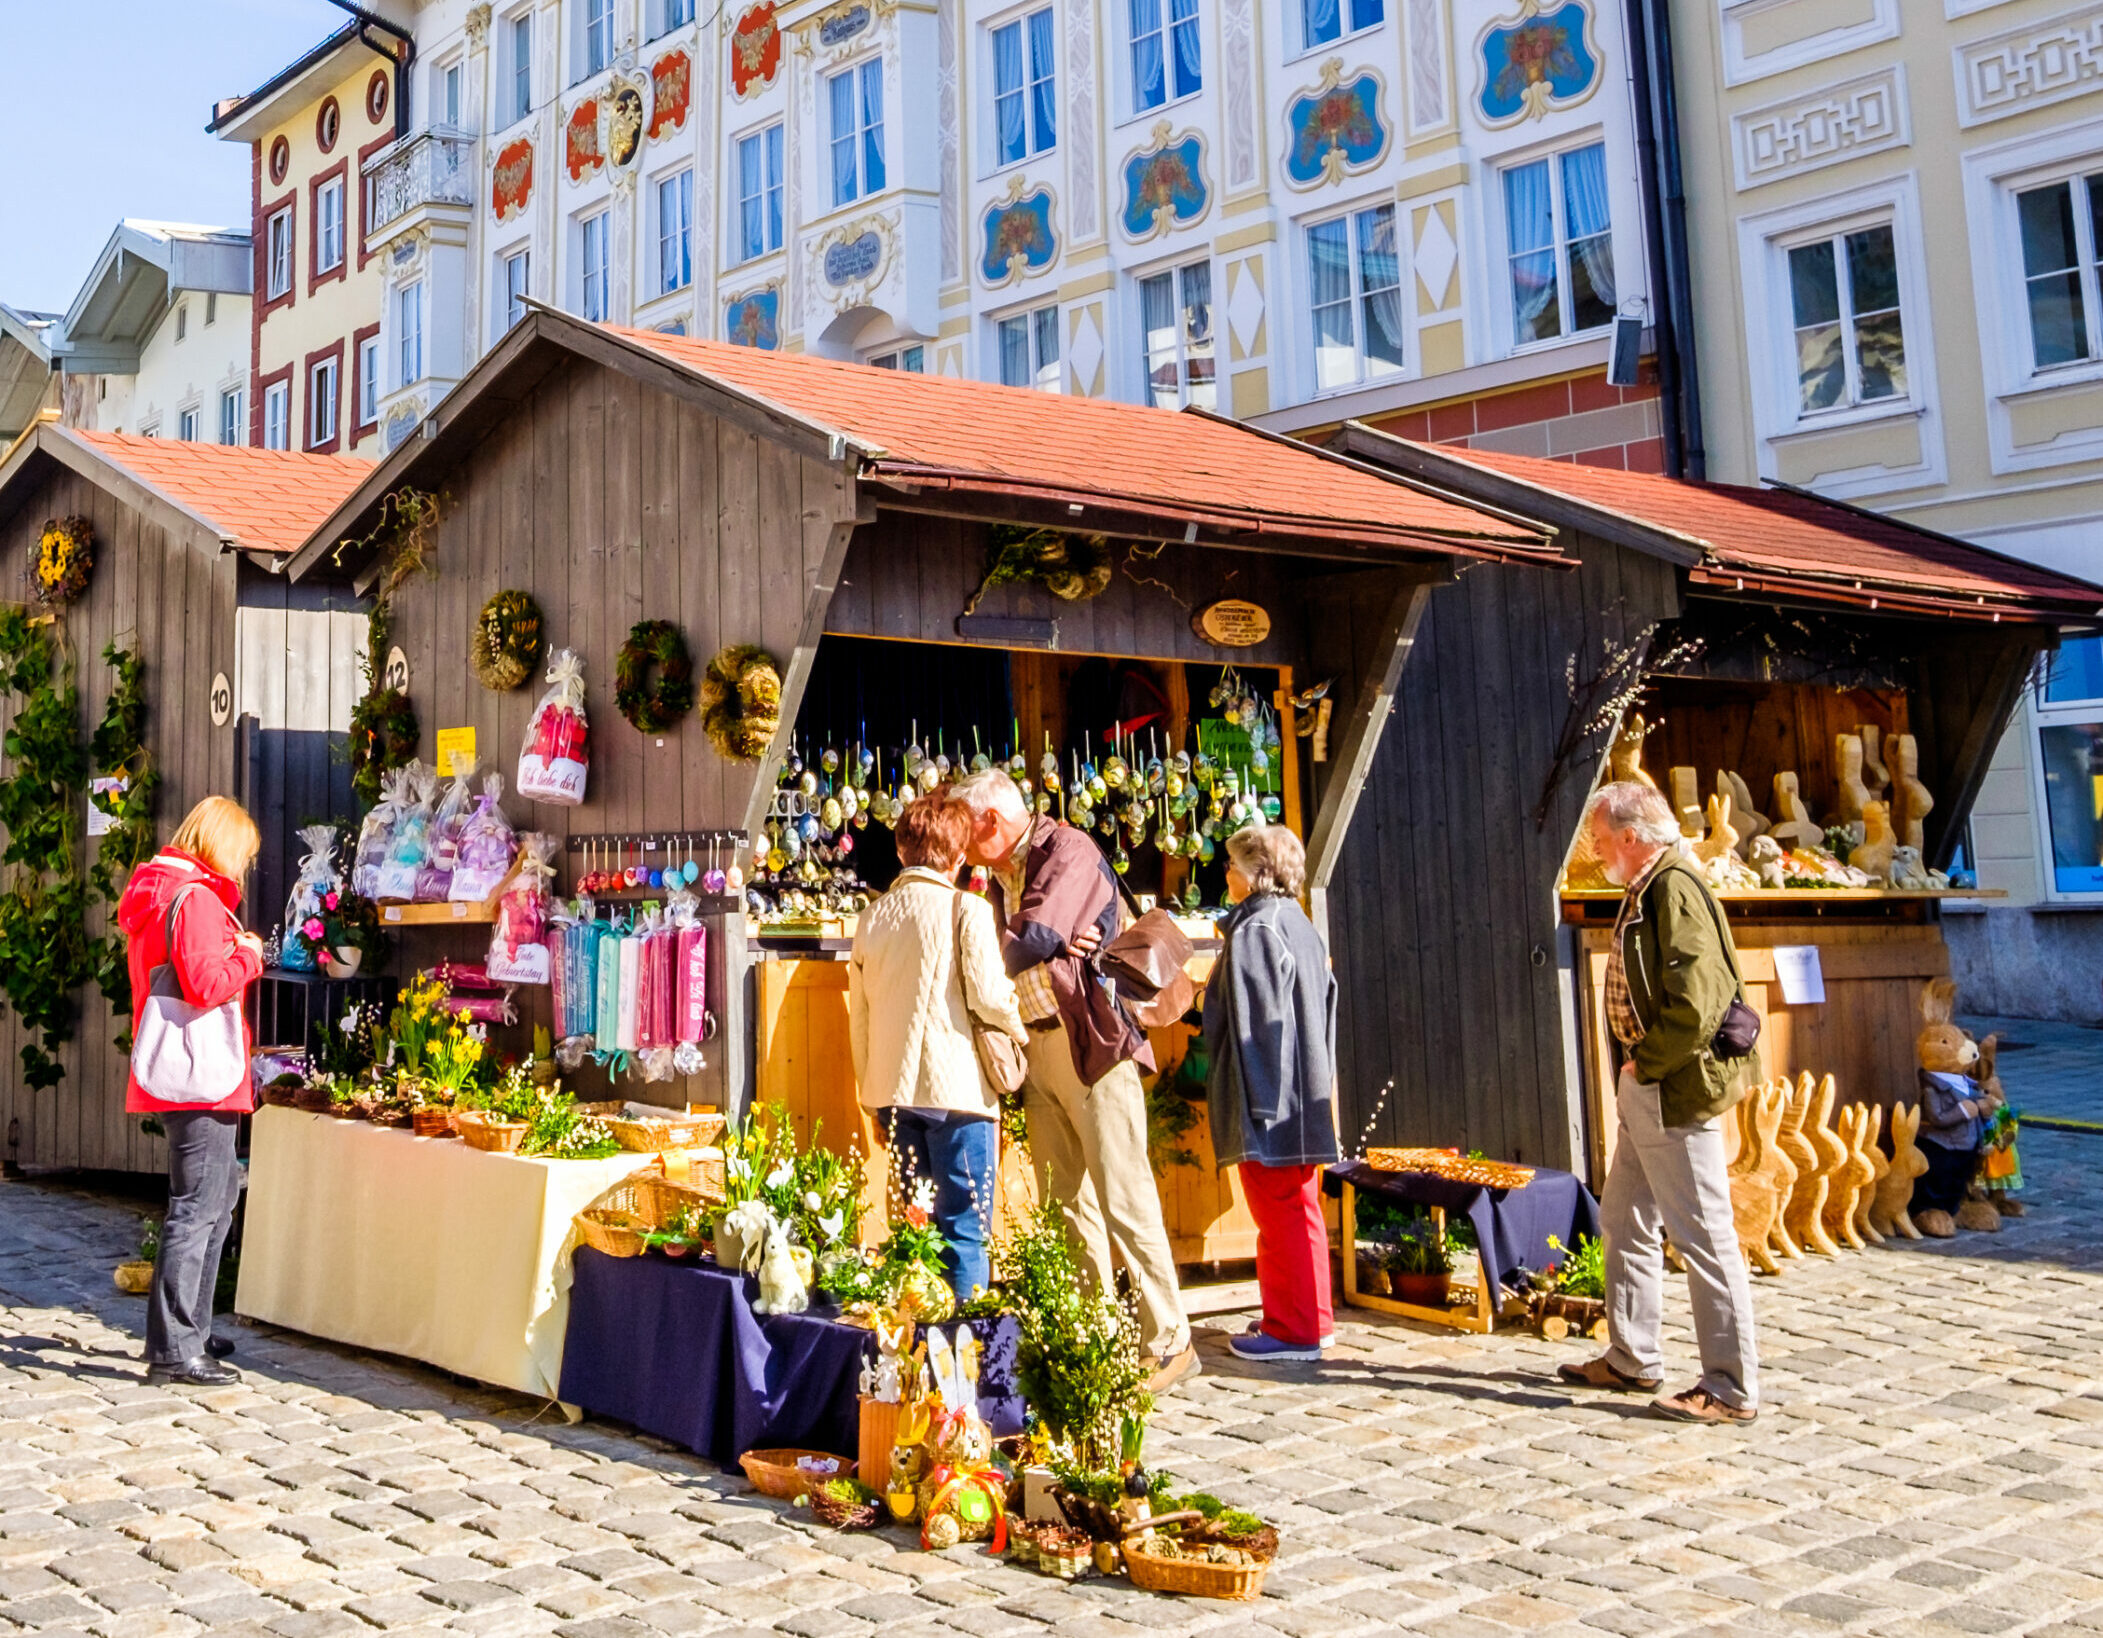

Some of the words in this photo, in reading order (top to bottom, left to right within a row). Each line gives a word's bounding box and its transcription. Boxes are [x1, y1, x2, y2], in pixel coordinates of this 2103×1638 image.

[387, 661, 406, 689] 12
[212, 689, 228, 714] 10
[560, 773, 580, 791] dich
